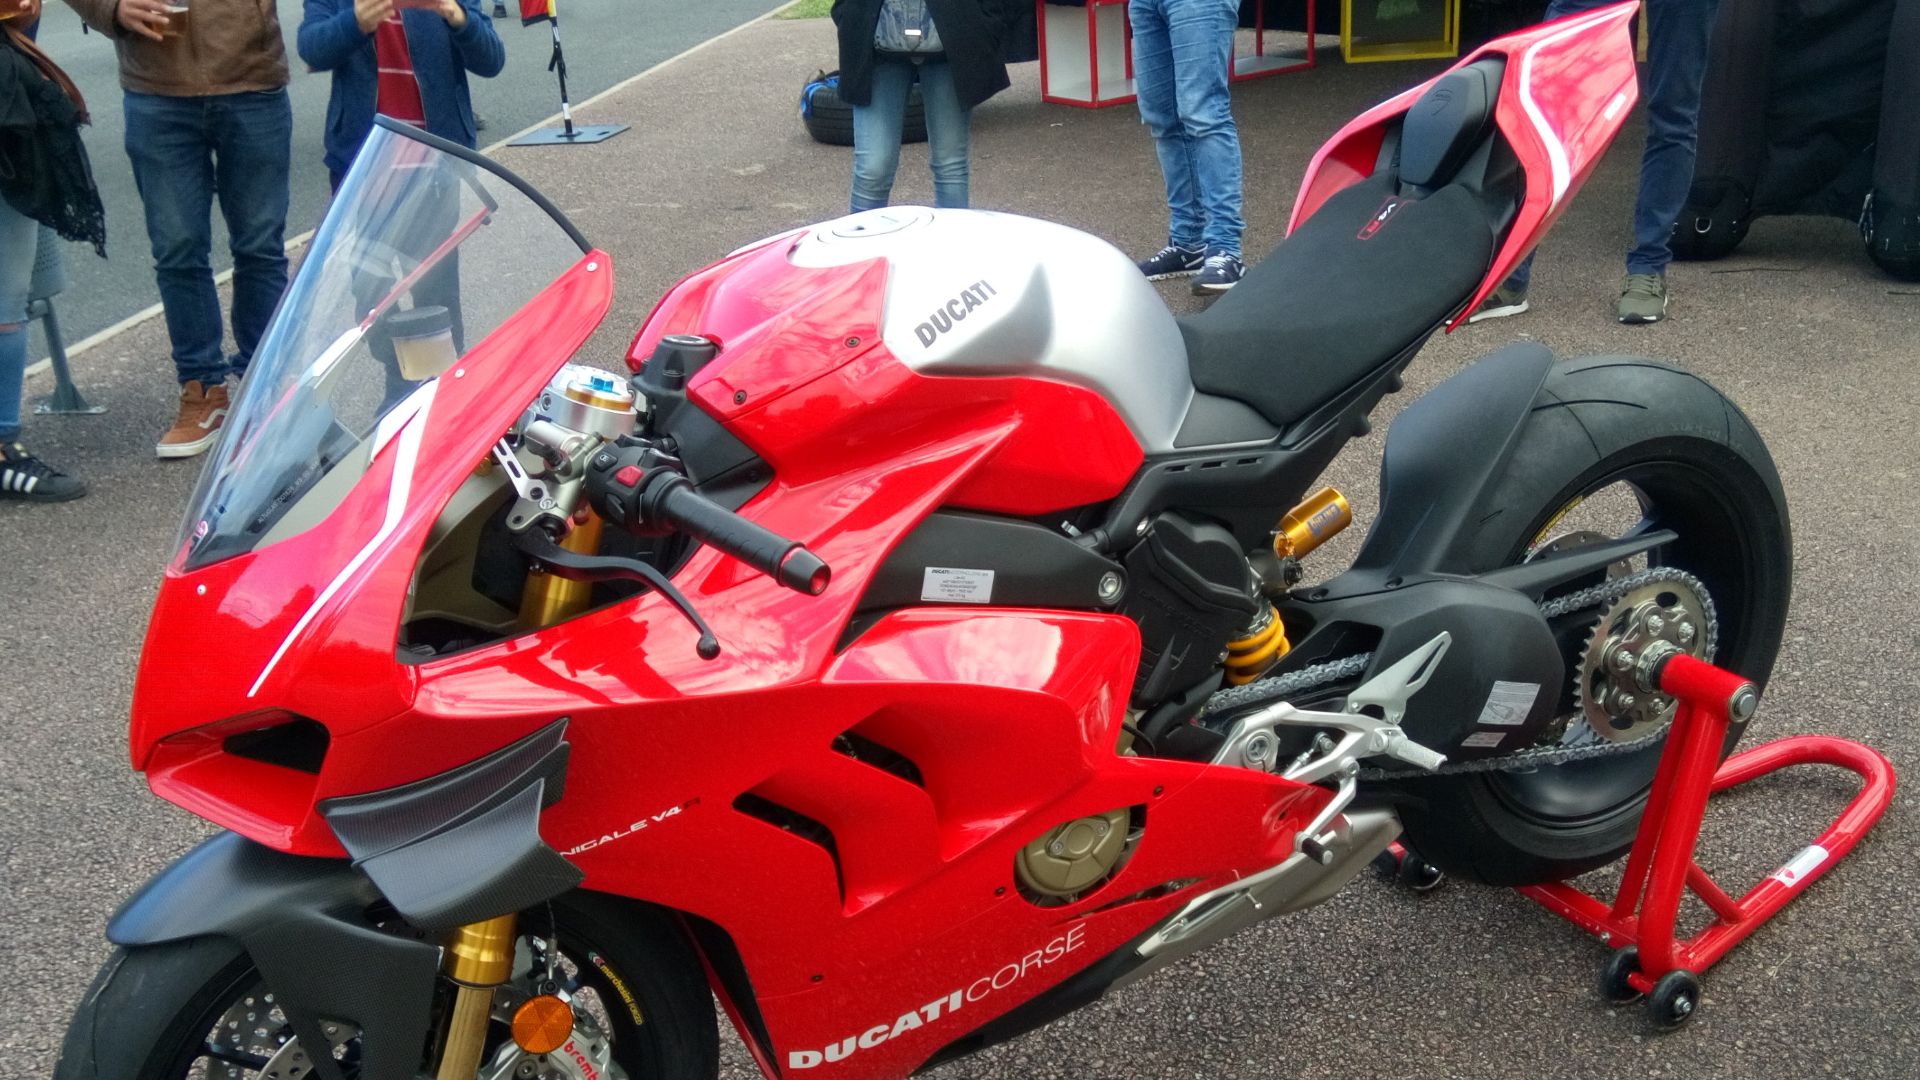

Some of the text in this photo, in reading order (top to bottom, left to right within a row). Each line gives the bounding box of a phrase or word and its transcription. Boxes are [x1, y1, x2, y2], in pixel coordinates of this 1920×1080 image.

[914, 280, 997, 349] DUCATI
[789, 922, 1087, 1069] DUCATI CORSE
